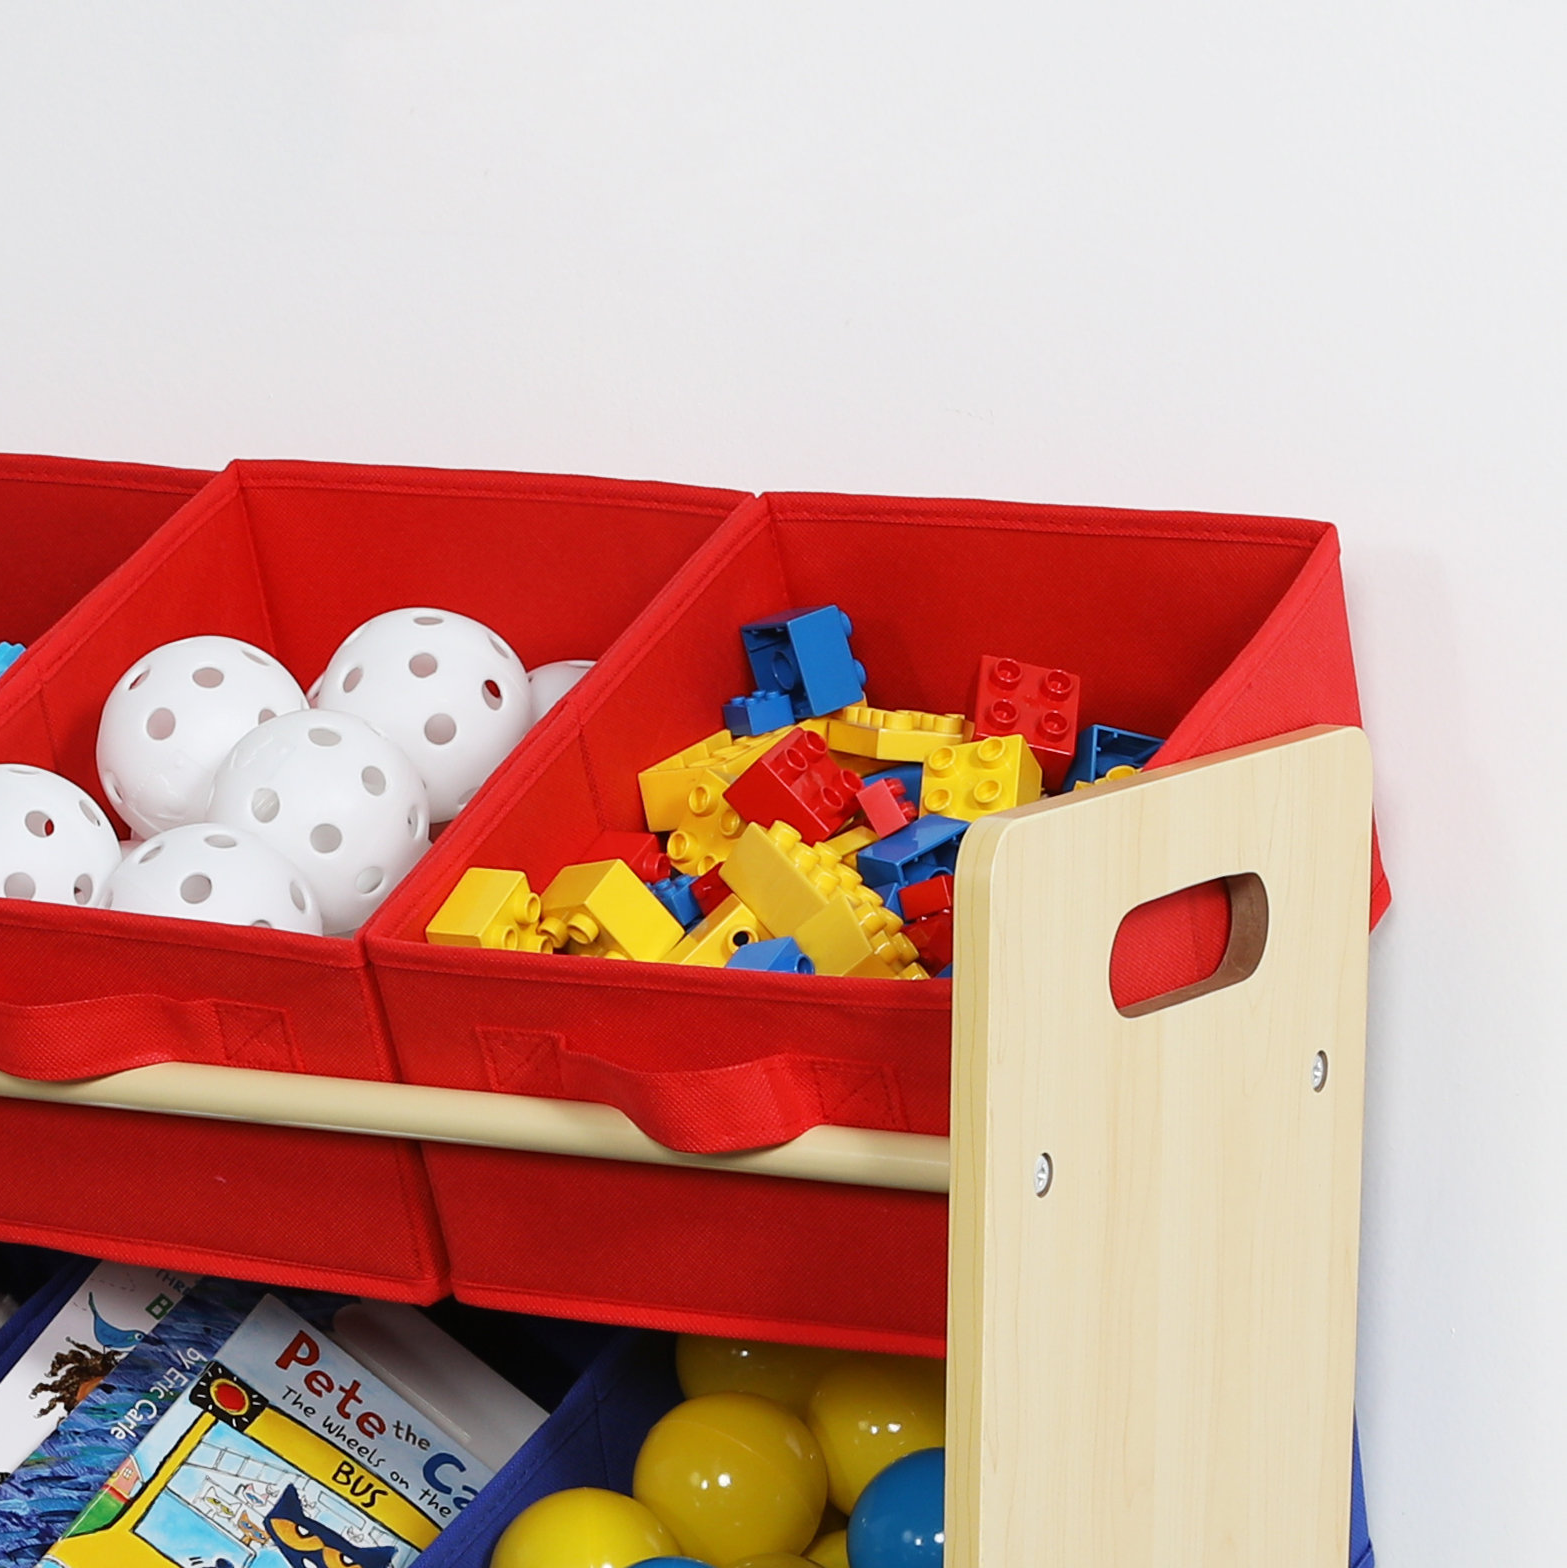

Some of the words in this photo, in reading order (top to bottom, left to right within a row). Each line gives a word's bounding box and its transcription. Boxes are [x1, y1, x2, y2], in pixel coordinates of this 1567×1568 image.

[177, 1347, 208, 1370] by
[150, 1366, 189, 1399] Eric
[275, 1329, 386, 1440] Pete
[392, 1420, 431, 1451] the
[110, 1399, 157, 1440] Carle
[281, 1385, 316, 1418] The
[322, 1415, 386, 1468] Wheels
[390, 1470, 410, 1490] on
[418, 1487, 452, 1519] the
[331, 1460, 389, 1509] BUS
